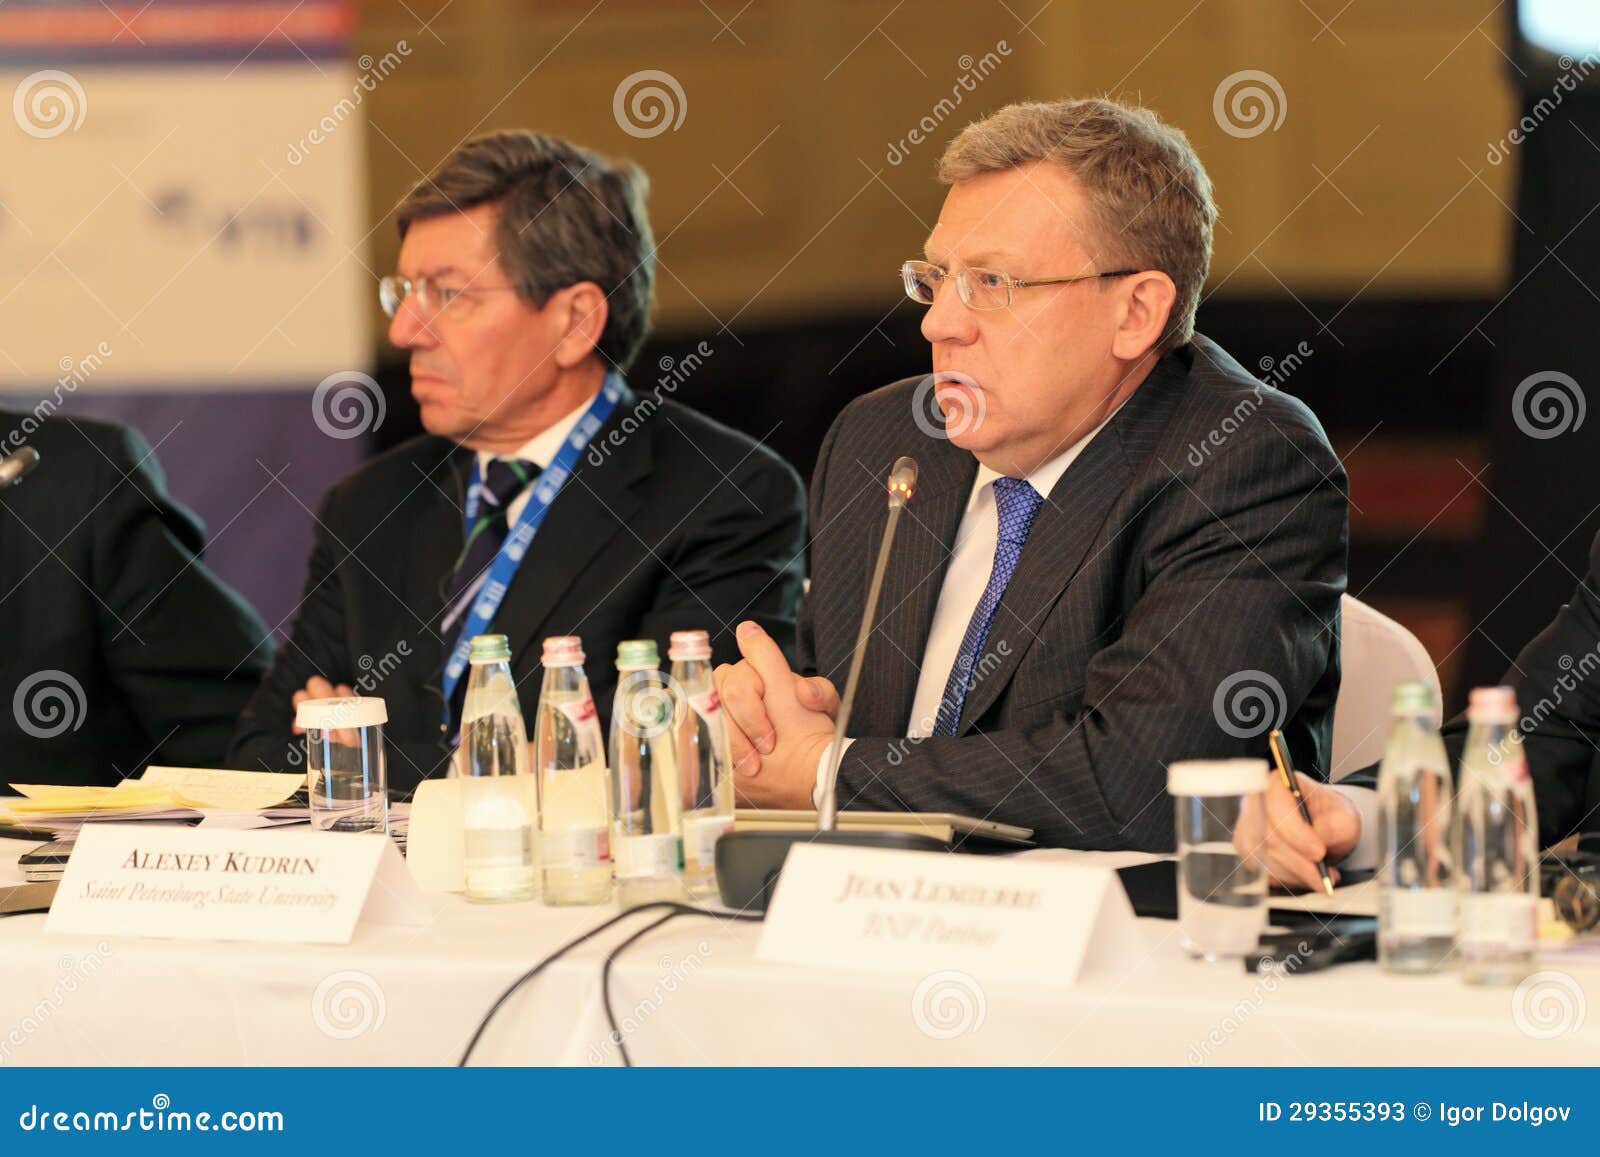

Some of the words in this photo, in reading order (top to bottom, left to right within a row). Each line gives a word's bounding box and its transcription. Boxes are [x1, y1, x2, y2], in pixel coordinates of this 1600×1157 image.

[121, 848, 217, 872] ALEXEY
[221, 851, 319, 875] KUDRIN
[80, 880, 128, 900] Saint
[127, 881, 209, 908] Petersburg
[211, 885, 252, 904] State
[258, 886, 339, 909] University
